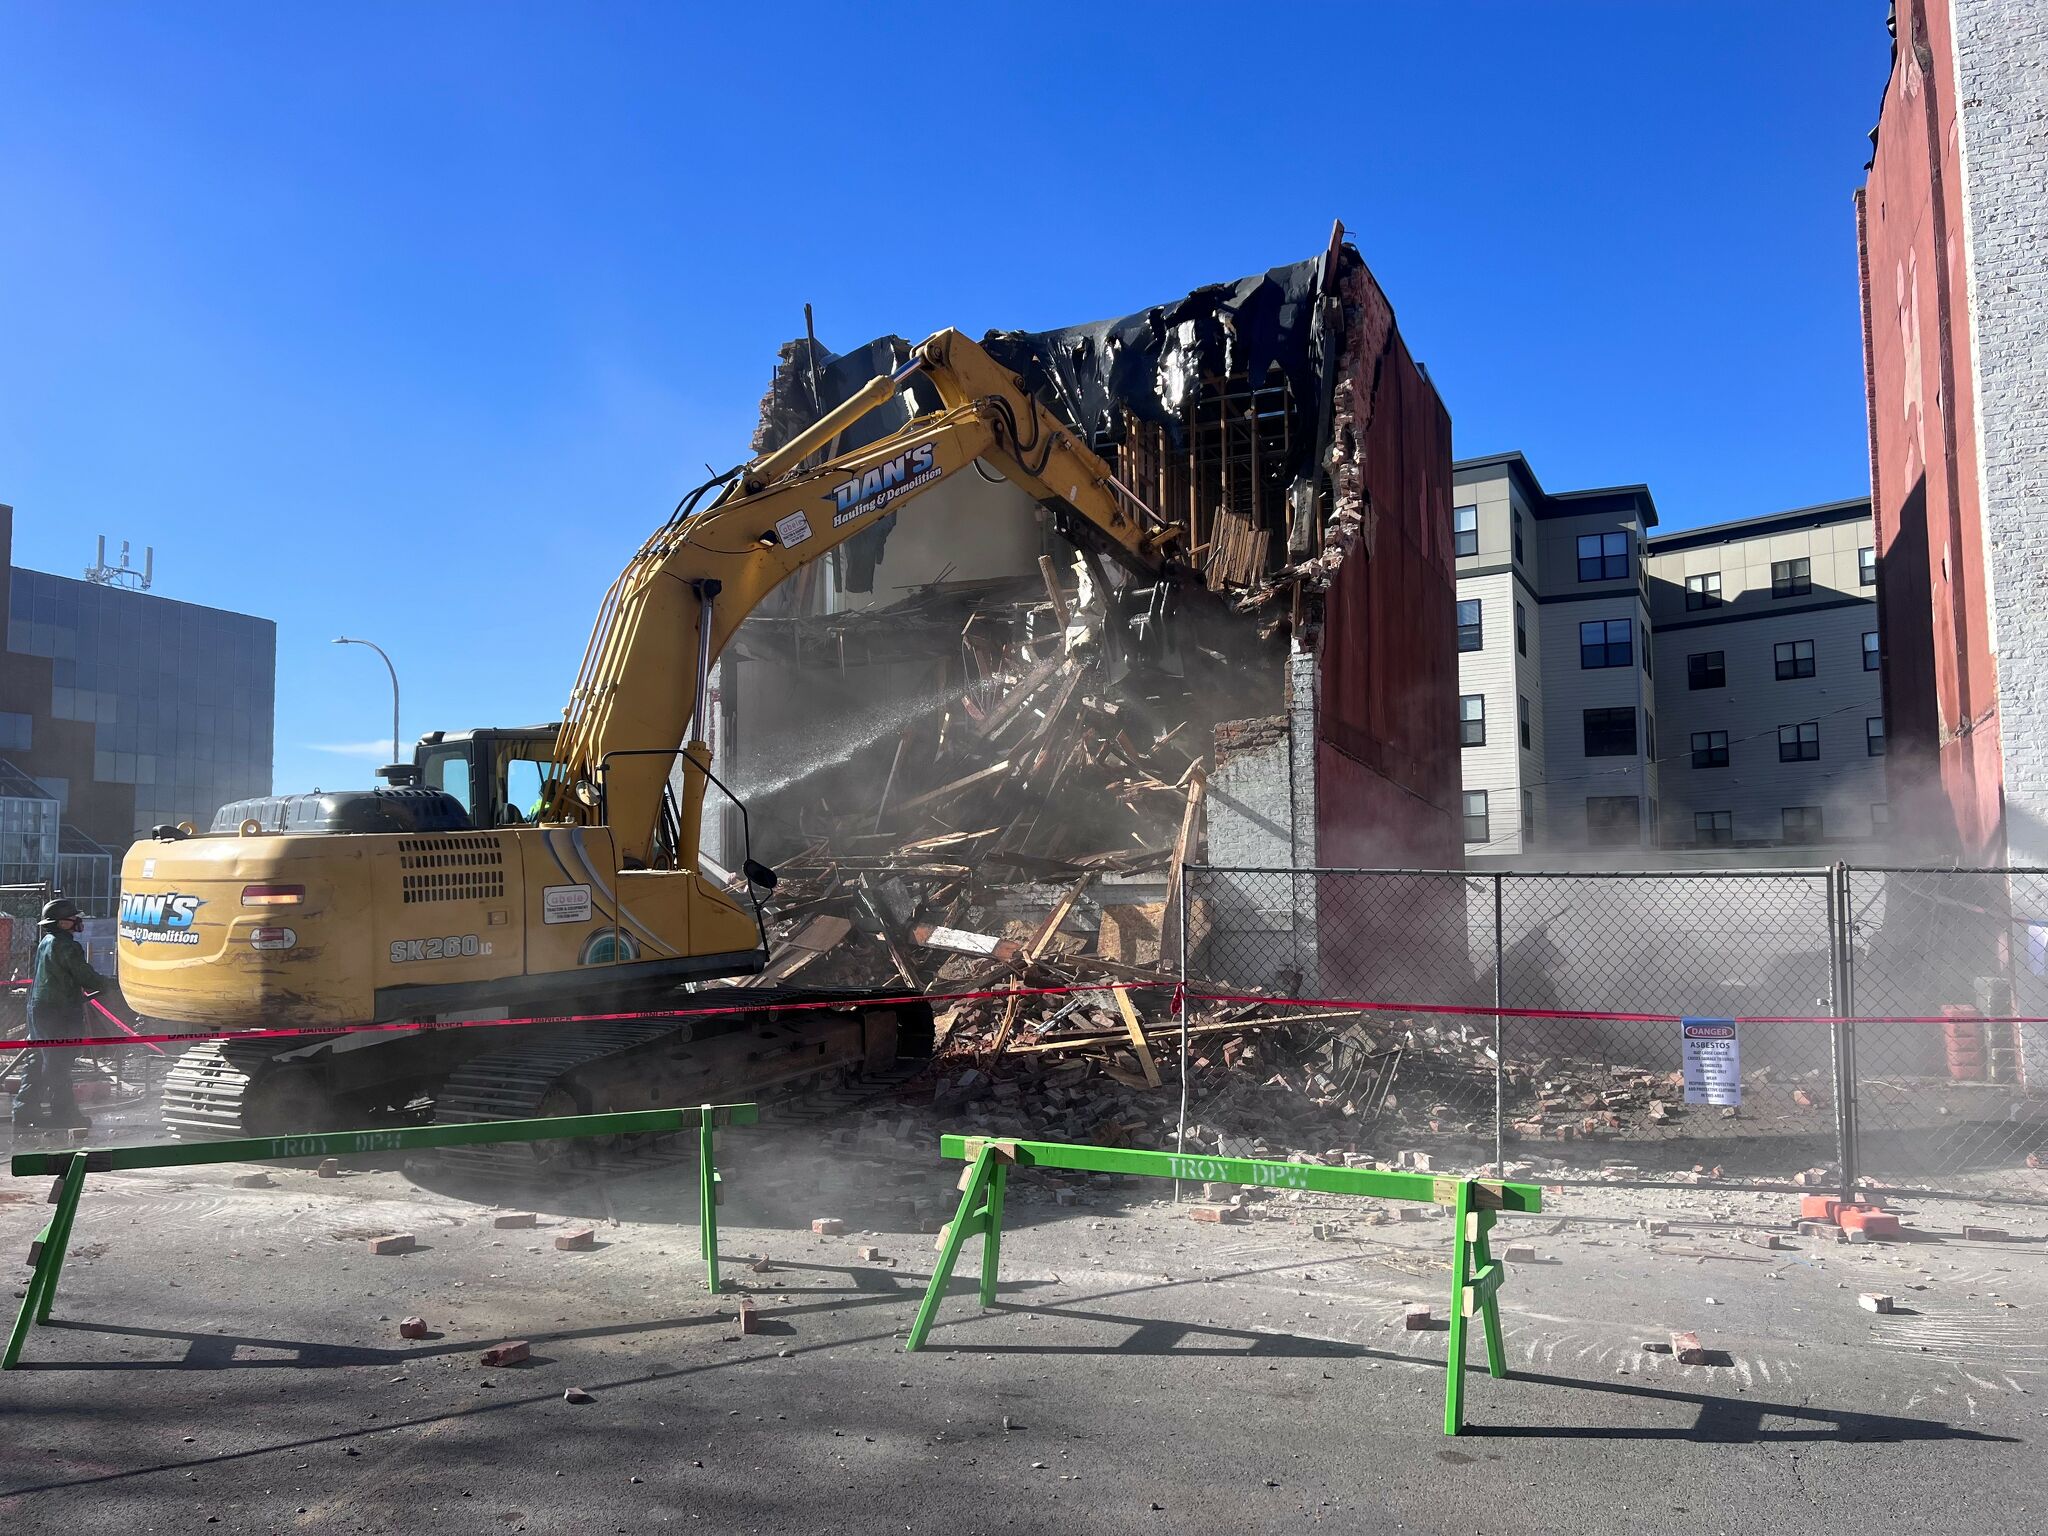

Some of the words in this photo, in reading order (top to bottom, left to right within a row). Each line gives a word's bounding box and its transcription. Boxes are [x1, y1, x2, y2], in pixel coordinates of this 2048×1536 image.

[833, 442, 934, 513] DAN'S
[833, 501, 877, 528] Hauling
[876, 493, 888, 506] &
[886, 467, 942, 501] Demolition
[122, 893, 198, 927] DAN'S
[142, 928, 199, 944] Demolition
[390, 935, 479, 962] SK260
[1690, 1041, 1731, 1049] ASBESTOS
[1691, 1027, 1729, 1036] DANGER
[1168, 1157, 1229, 1181] TROY
[1253, 1163, 1309, 1188] DPW
